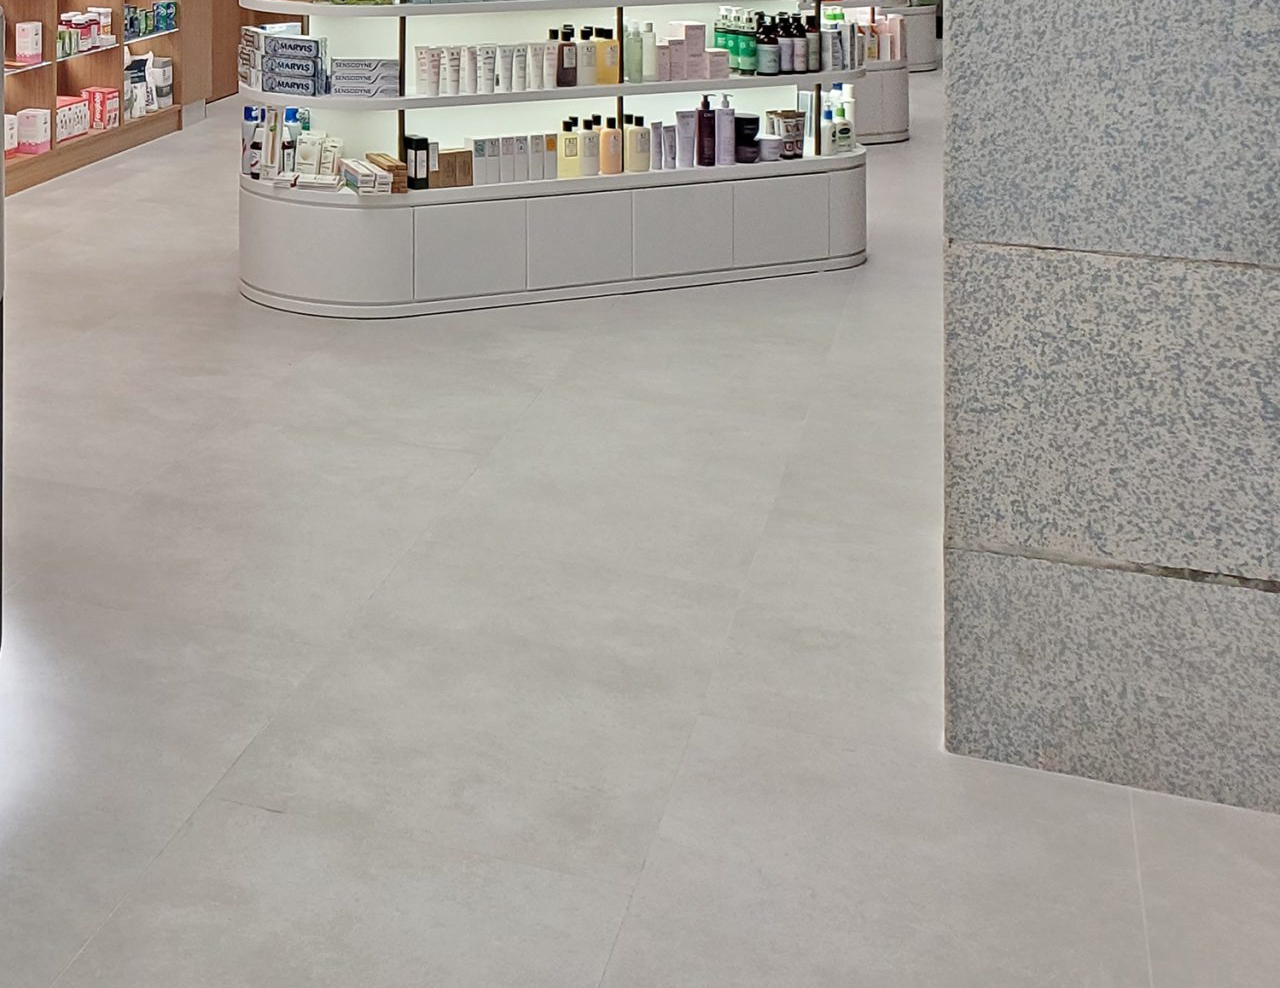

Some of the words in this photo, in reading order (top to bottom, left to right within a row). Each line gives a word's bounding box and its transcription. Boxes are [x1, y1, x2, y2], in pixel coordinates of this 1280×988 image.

[280, 43, 313, 53] MARVIS
[277, 61, 310, 72] MARVIS
[277, 80, 310, 92] MARVIS
[333, 87, 371, 95] SENSODYNE
